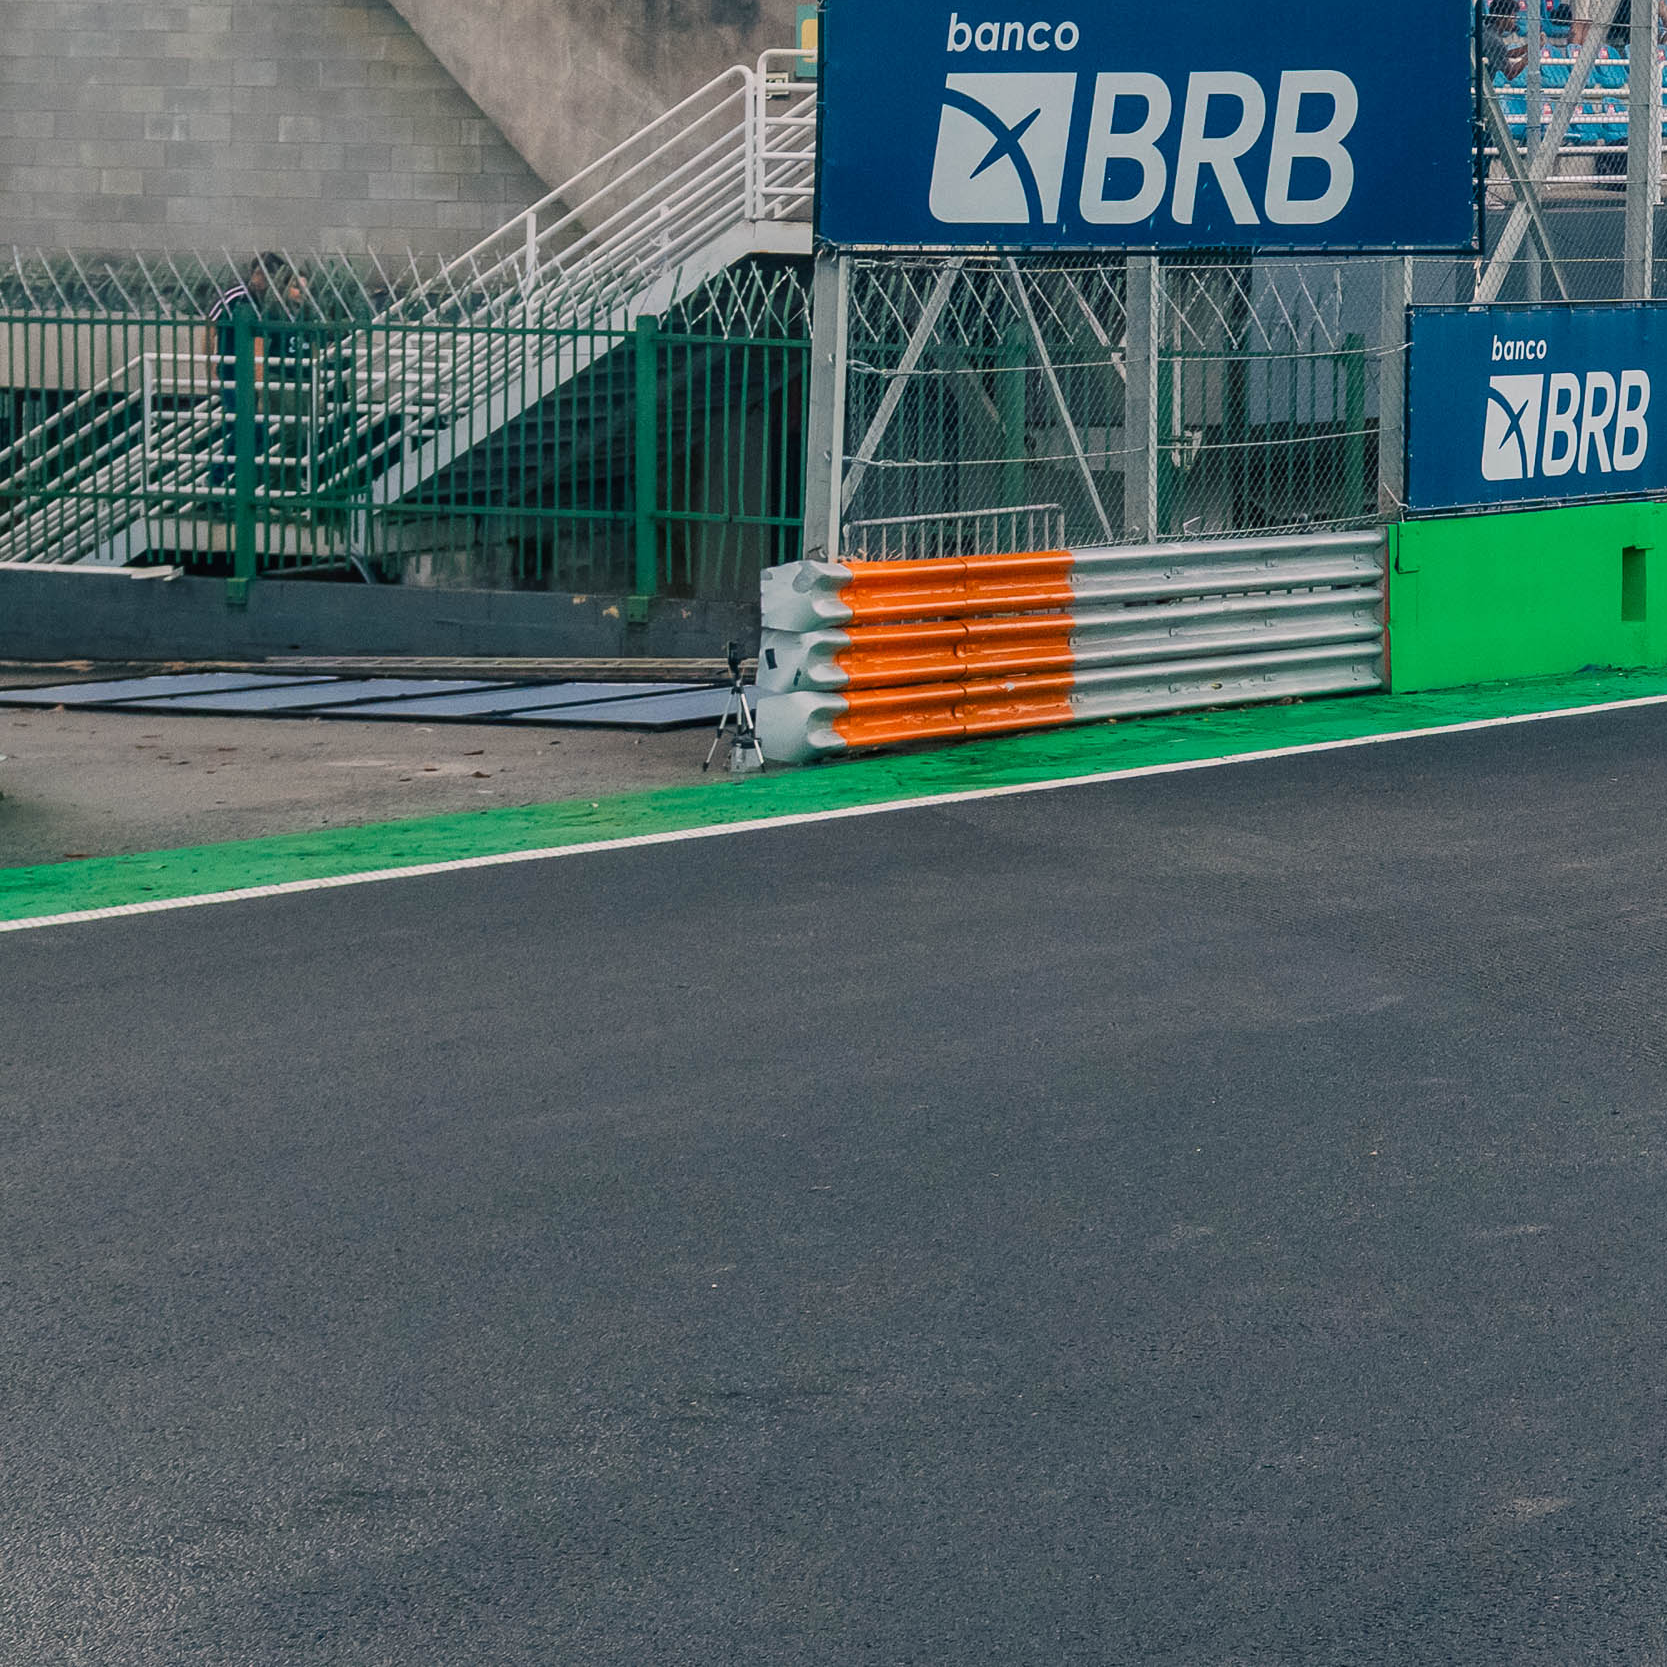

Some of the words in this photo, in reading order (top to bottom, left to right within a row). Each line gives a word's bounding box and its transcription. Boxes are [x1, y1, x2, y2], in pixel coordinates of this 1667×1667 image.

[947, 13, 1079, 52] banco
[1079, 69, 1359, 225] BRB
[1491, 335, 1548, 362] banco
[1542, 369, 1651, 473] BRB
